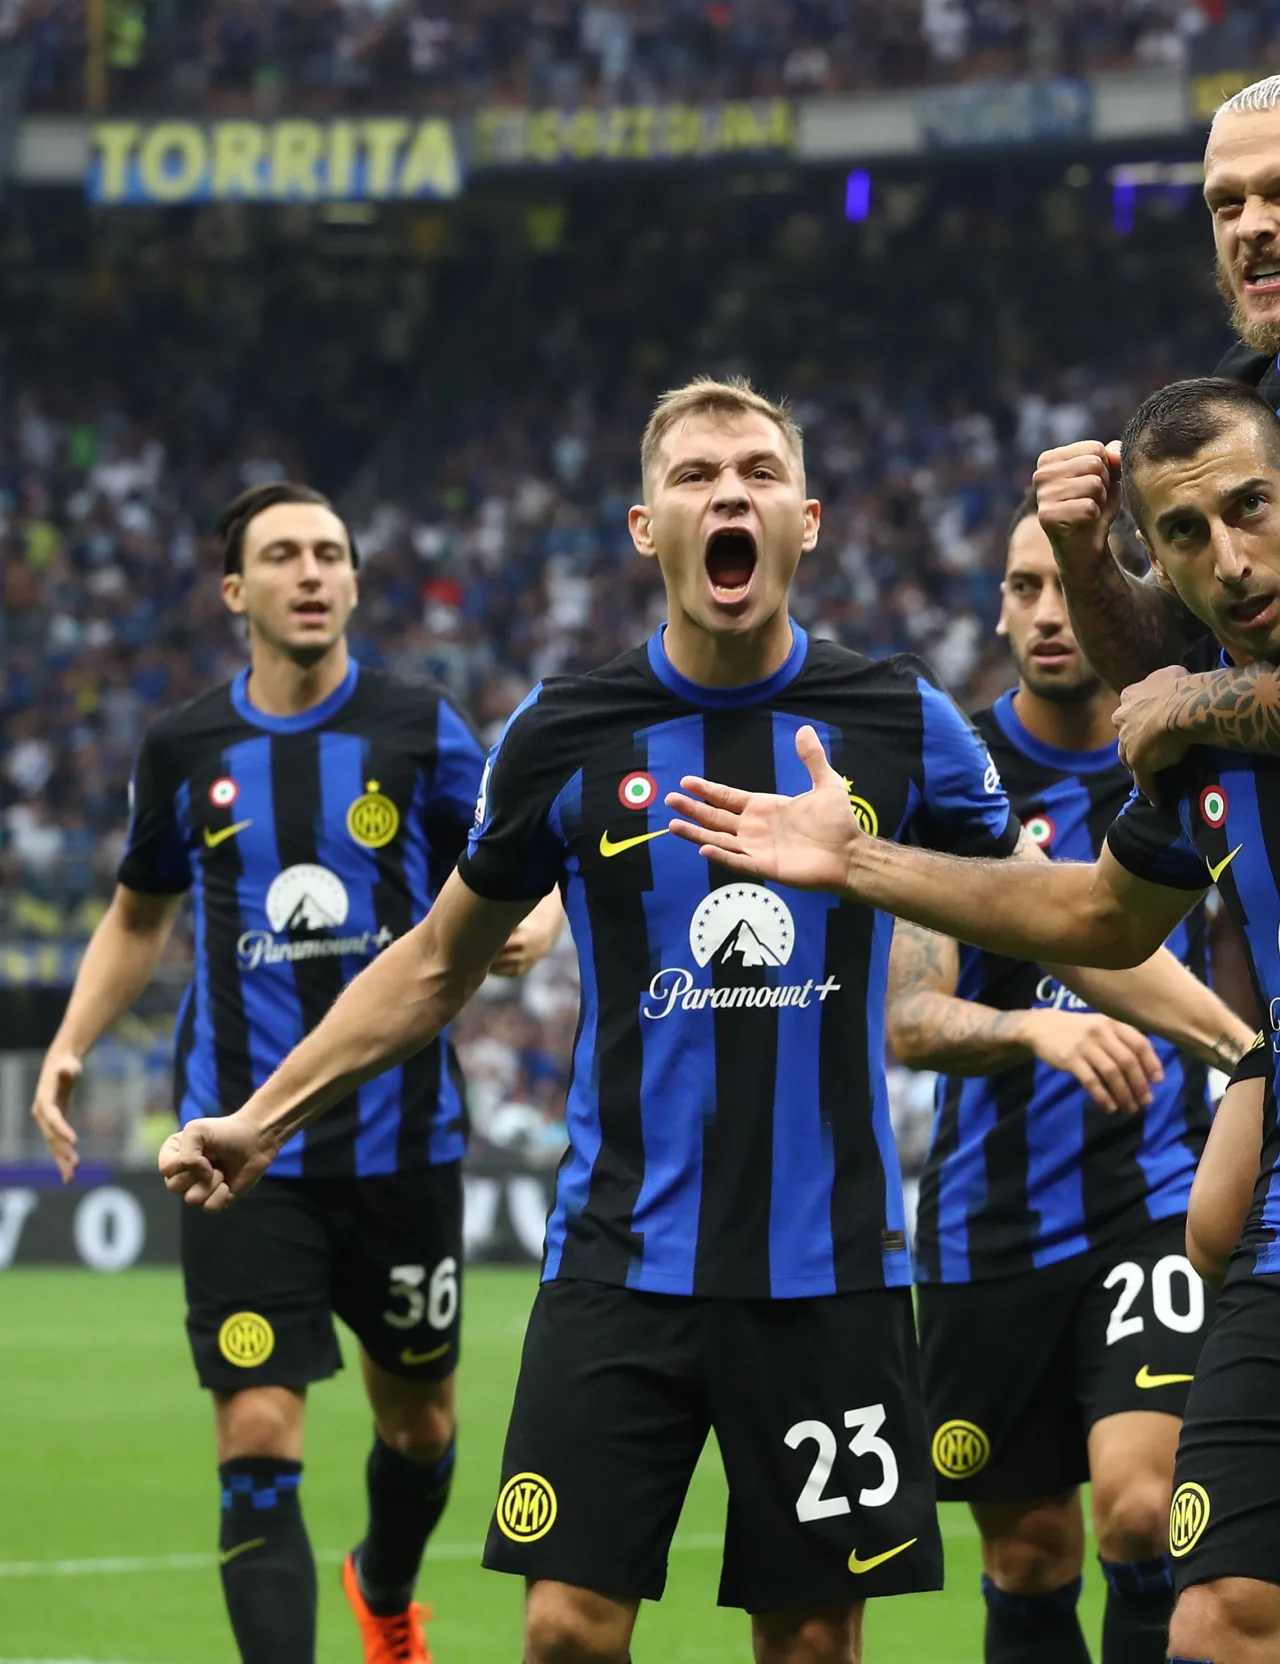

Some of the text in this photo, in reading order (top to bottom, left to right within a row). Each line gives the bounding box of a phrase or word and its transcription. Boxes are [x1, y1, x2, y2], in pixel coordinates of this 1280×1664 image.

[92, 118, 464, 200] TORRITA
[643, 967, 842, 1020] Paramount+
[384, 1256, 459, 1330] 36
[1102, 1250, 1206, 1346] 20
[782, 1402, 900, 1524] 23
